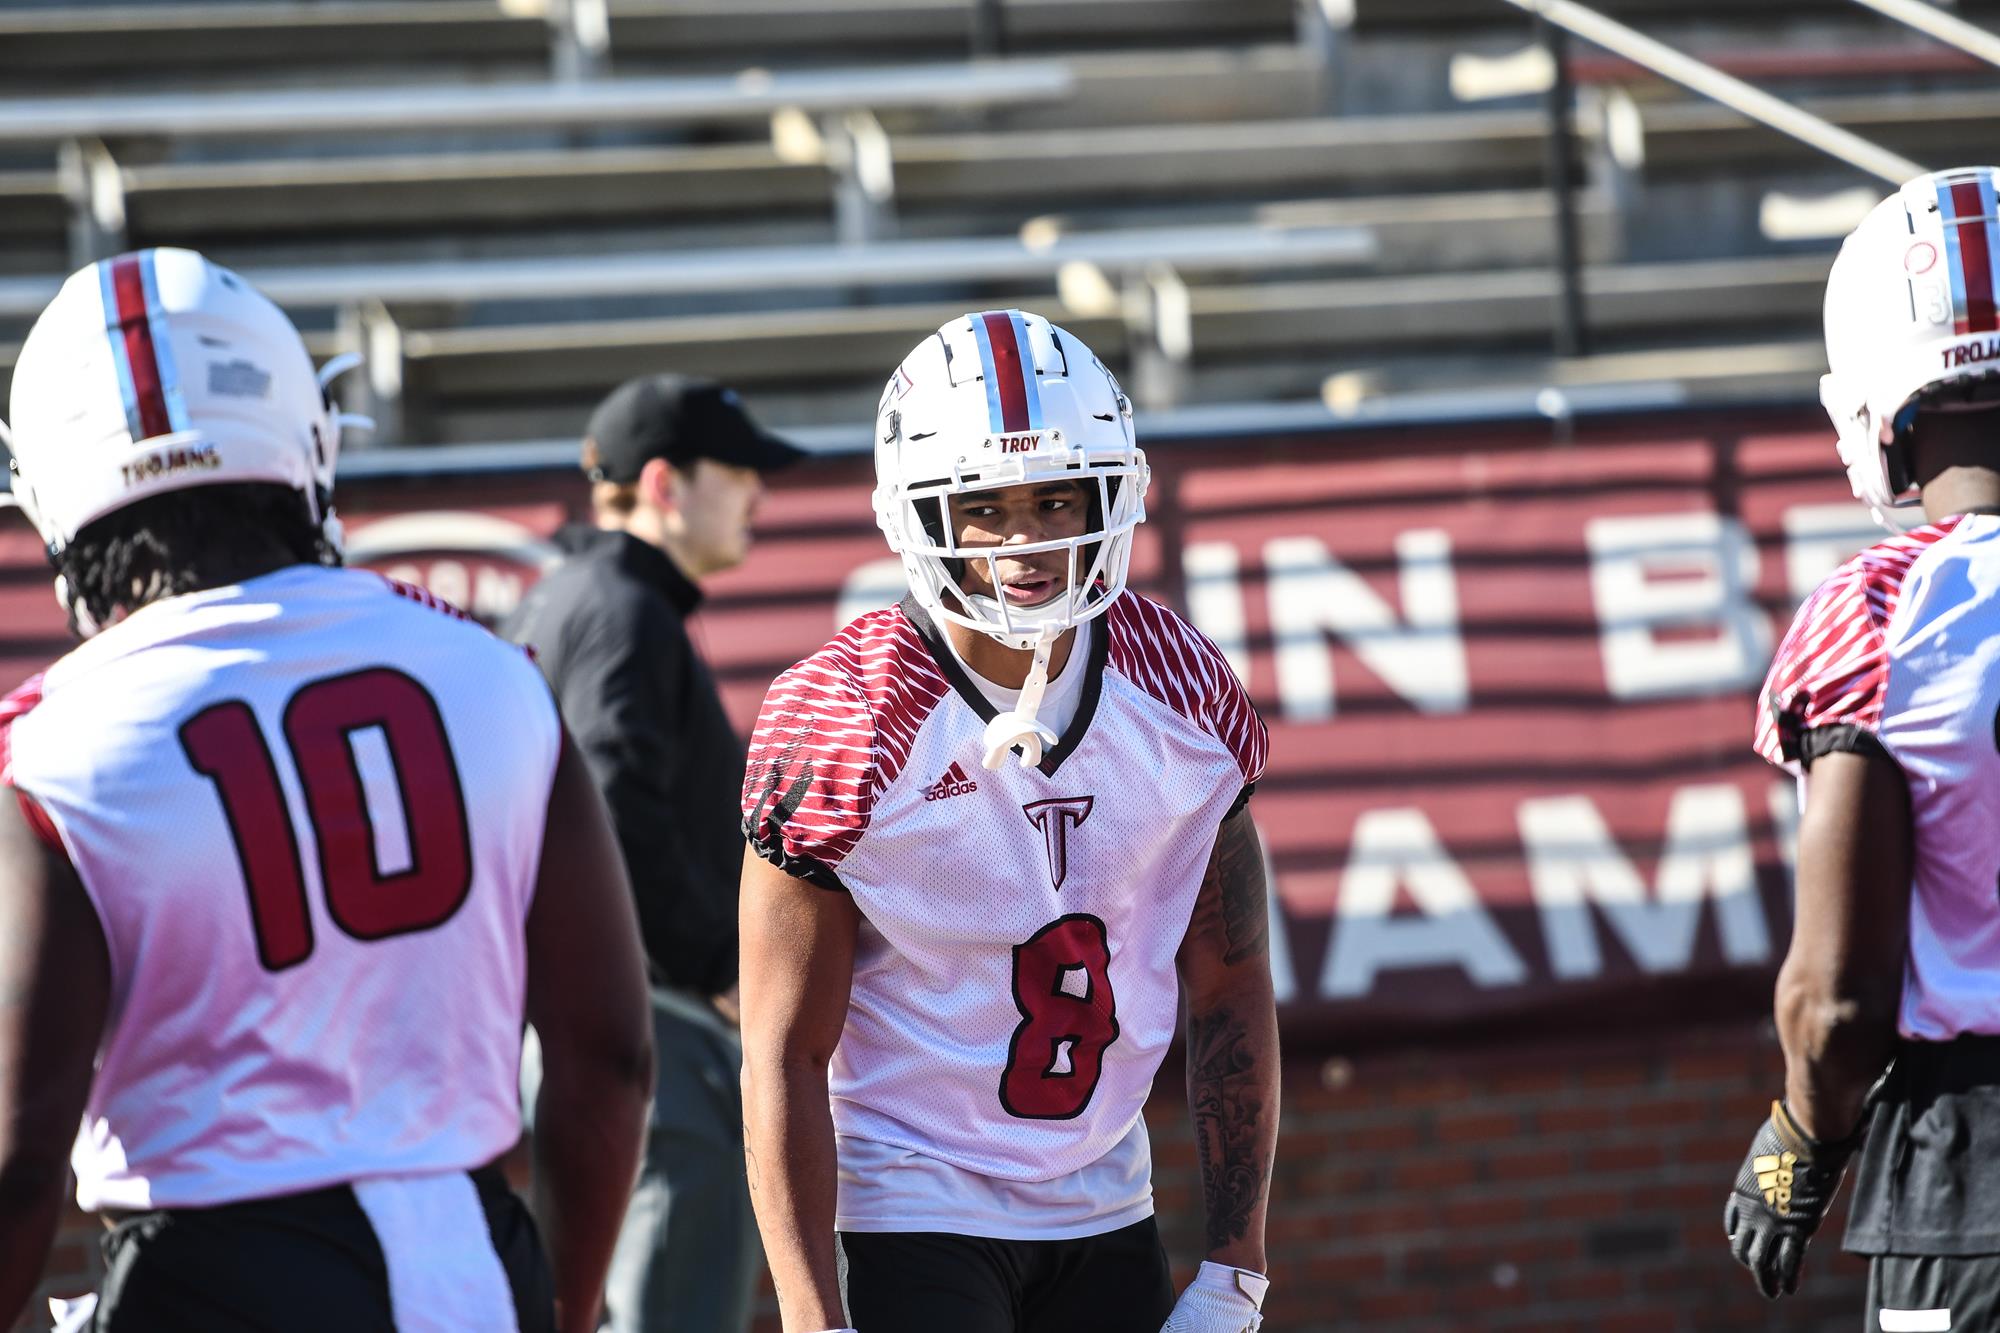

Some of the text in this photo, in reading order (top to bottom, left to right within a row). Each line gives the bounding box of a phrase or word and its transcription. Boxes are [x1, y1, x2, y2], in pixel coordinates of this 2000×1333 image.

[1941, 338, 2000, 369] TROJ
[1000, 435, 1040, 454] TROY
[121, 443, 222, 487] TROJANS
[924, 780, 978, 802] adidas
[178, 666, 473, 974] 10
[998, 912, 1120, 1120] 8
